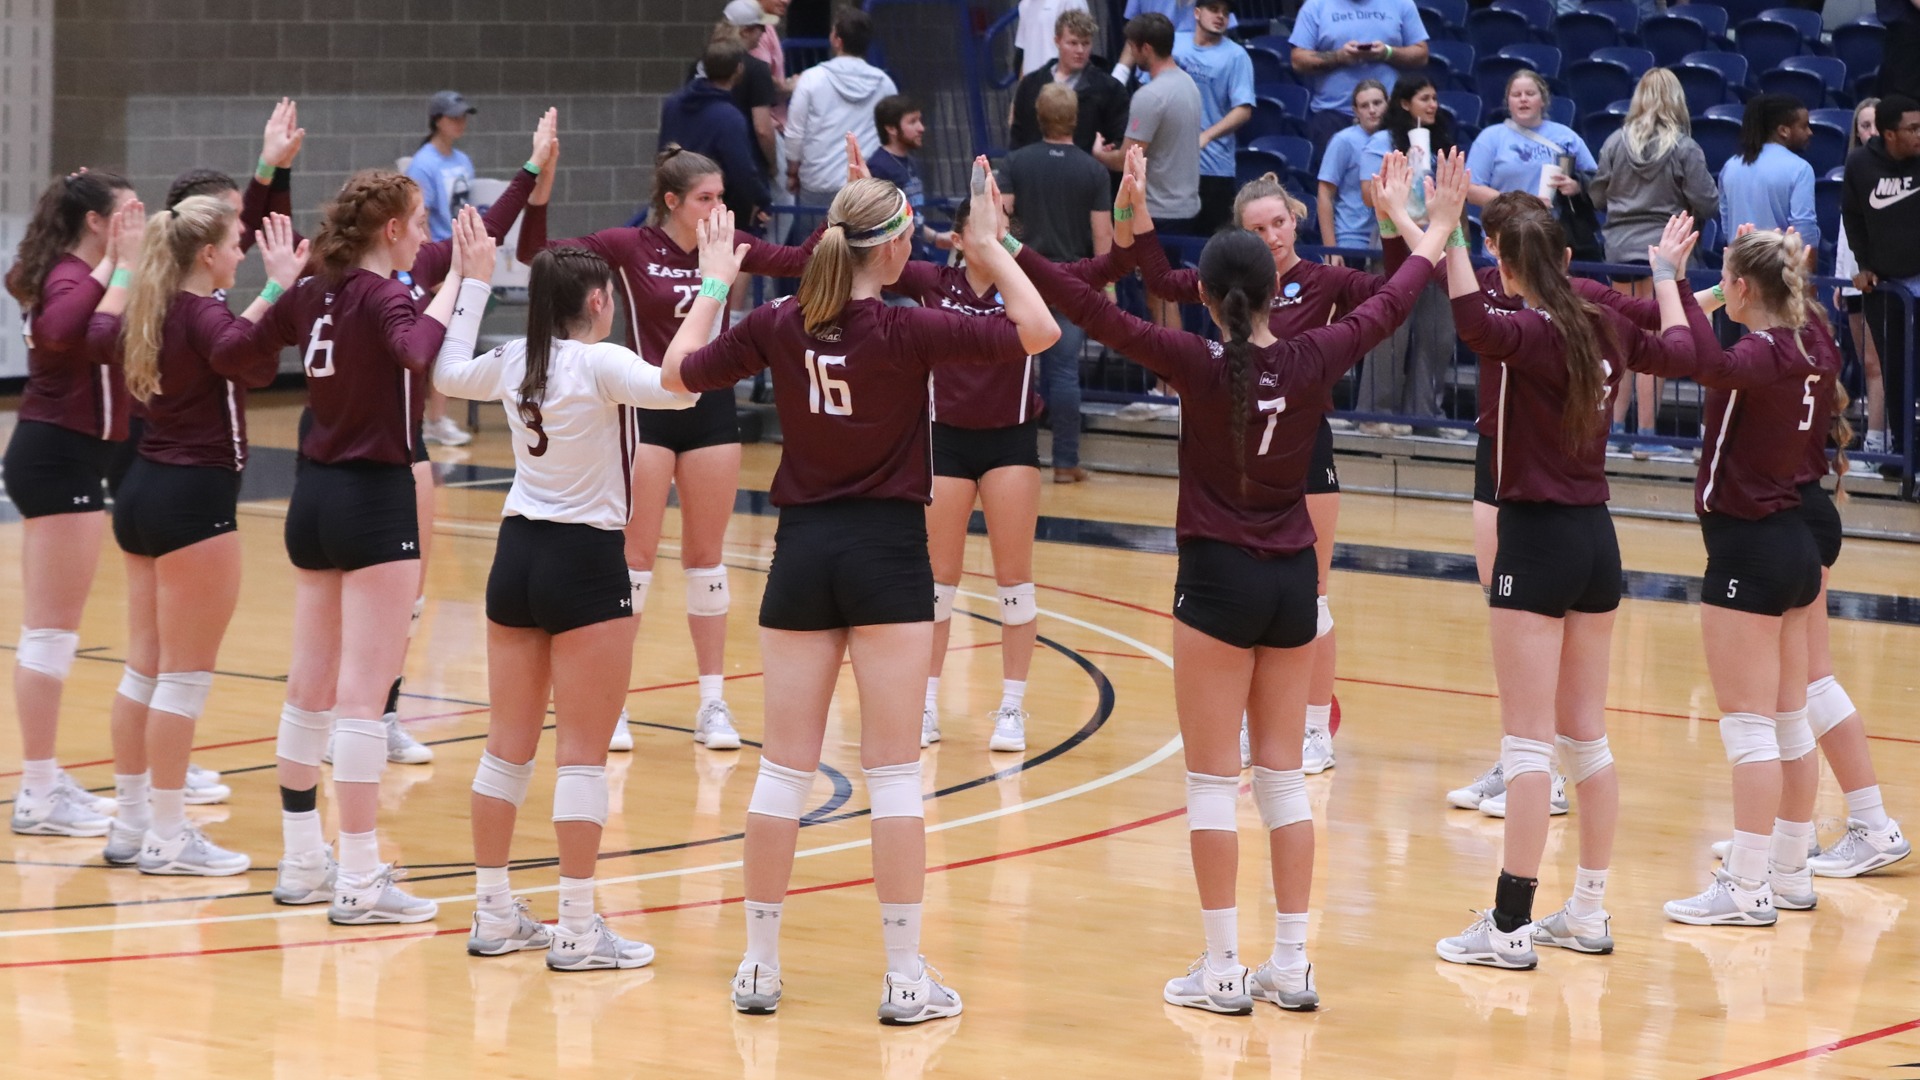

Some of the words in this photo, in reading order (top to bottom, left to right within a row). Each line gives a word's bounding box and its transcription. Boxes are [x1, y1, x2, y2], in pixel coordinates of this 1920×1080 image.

[1876, 176, 1913, 196] NIKE
[804, 349, 853, 416] 16
[1797, 374, 1821, 431] 5
[518, 402, 549, 457] 3
[1257, 396, 1287, 456] 7
[1498, 574, 1514, 597] 18
[1726, 578, 1739, 599] 5
